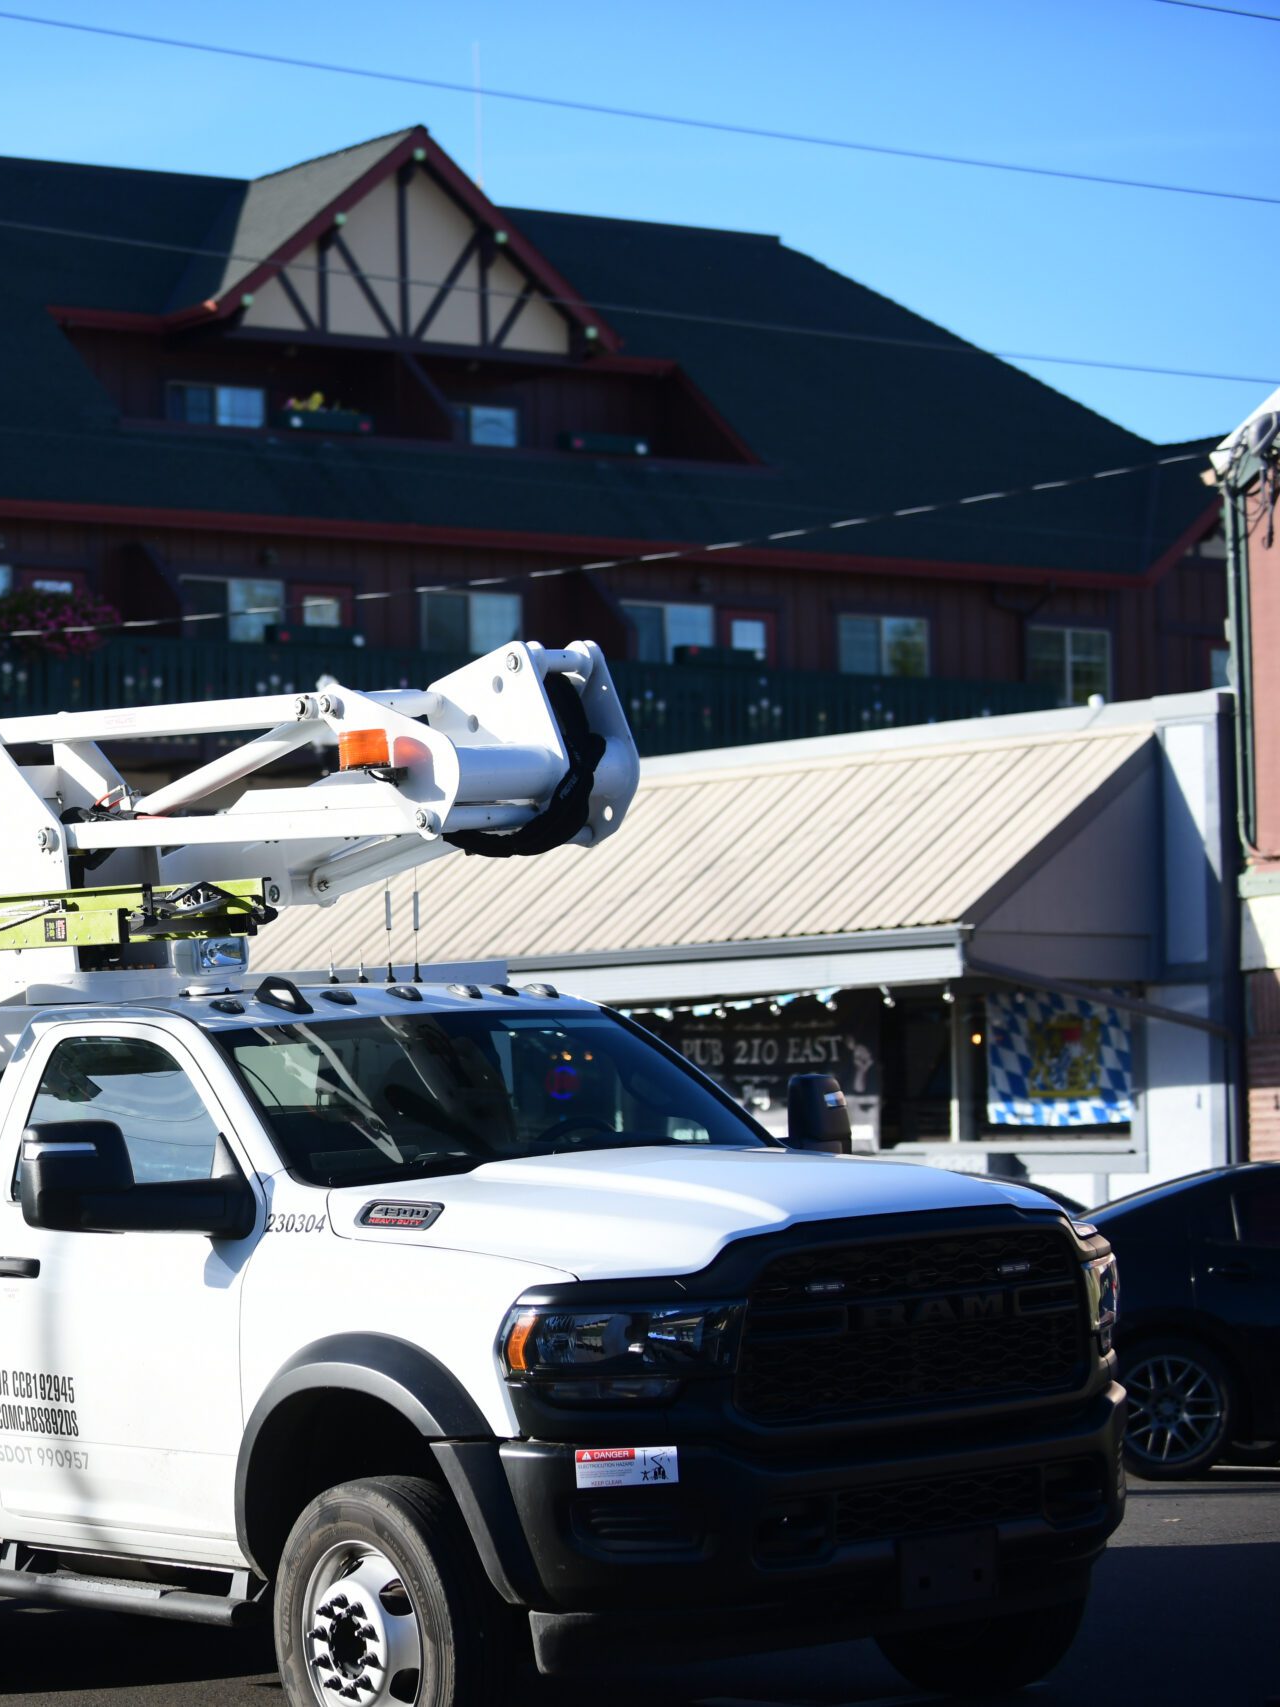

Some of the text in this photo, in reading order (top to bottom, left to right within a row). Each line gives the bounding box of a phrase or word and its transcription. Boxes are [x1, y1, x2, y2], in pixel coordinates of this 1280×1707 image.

[682, 1037, 724, 1066] PUB
[786, 1035, 842, 1063] EAST
[266, 1213, 327, 1233] 230304
[864, 1293, 1004, 1328] RAM
[12, 1371, 75, 1404] CCB192945
[37, 1447, 89, 1470] 990957
[593, 1451, 629, 1459] DANGER
